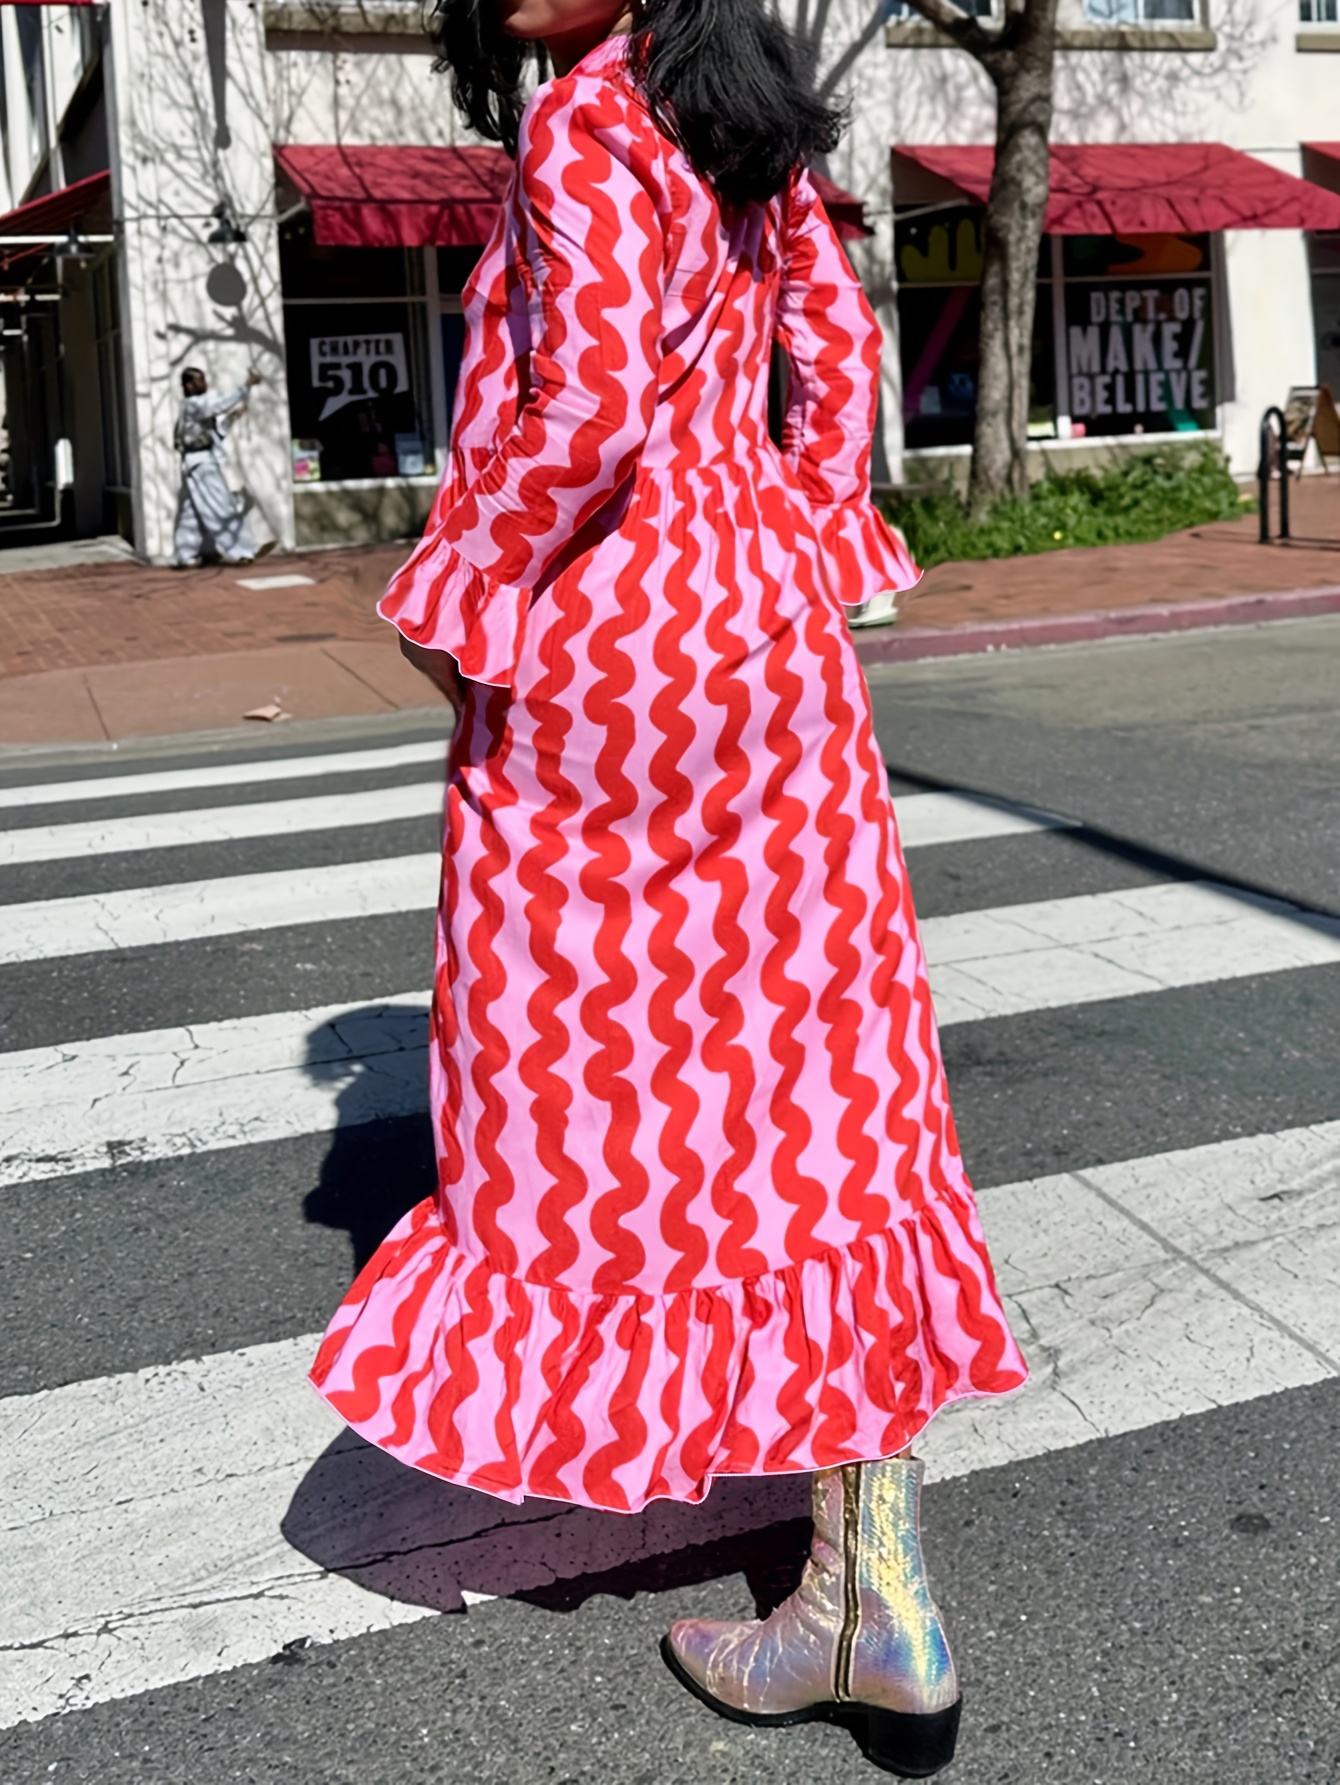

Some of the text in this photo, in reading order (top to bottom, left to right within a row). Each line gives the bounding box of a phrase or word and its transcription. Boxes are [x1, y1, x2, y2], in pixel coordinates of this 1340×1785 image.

[1090, 287, 1206, 323] DEPT. OF
[318, 339, 395, 357] CHAPTER
[1069, 320, 1204, 374] MAKE/
[317, 360, 399, 398] 510
[1072, 370, 1208, 416] BELIEVE
